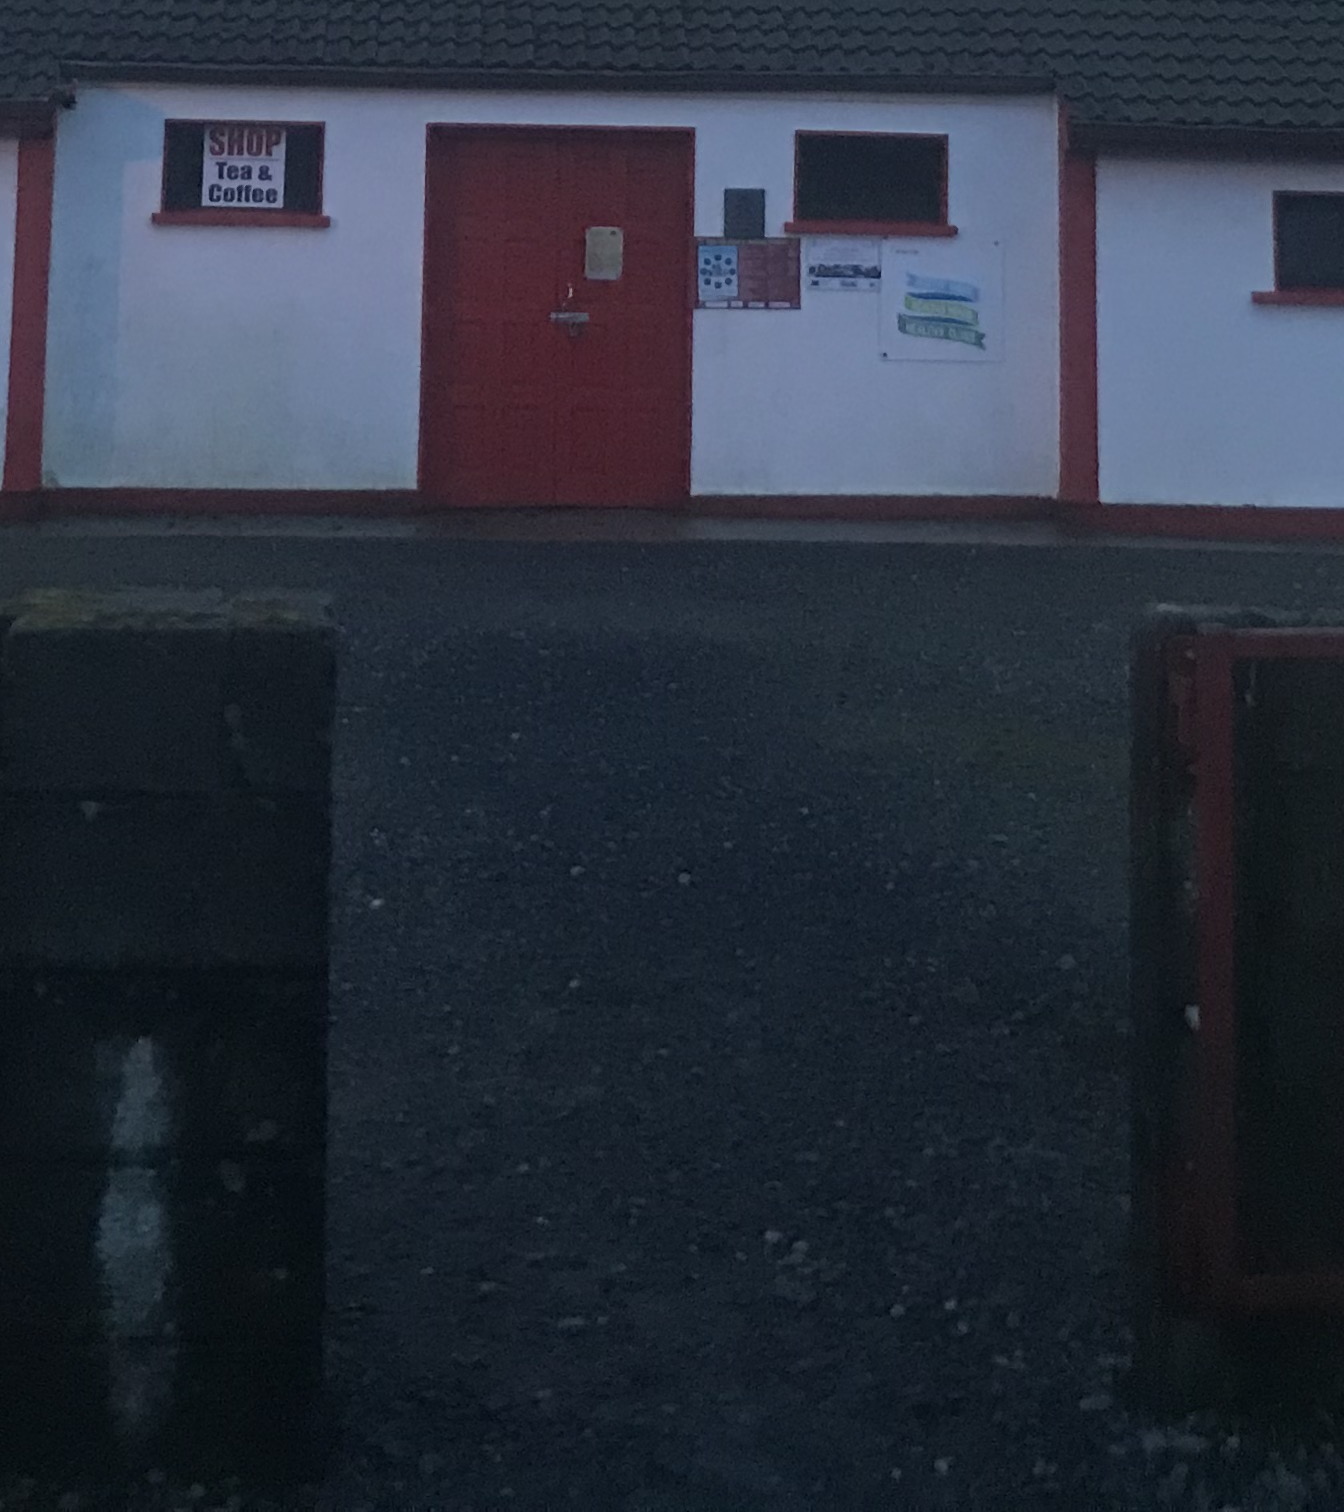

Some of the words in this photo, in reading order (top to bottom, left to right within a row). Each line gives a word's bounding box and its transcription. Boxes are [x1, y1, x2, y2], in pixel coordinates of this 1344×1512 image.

[209, 126, 283, 157] SHOP
[215, 161, 253, 180] Tea
[258, 164, 272, 181] &
[208, 183, 278, 204] Coffee
